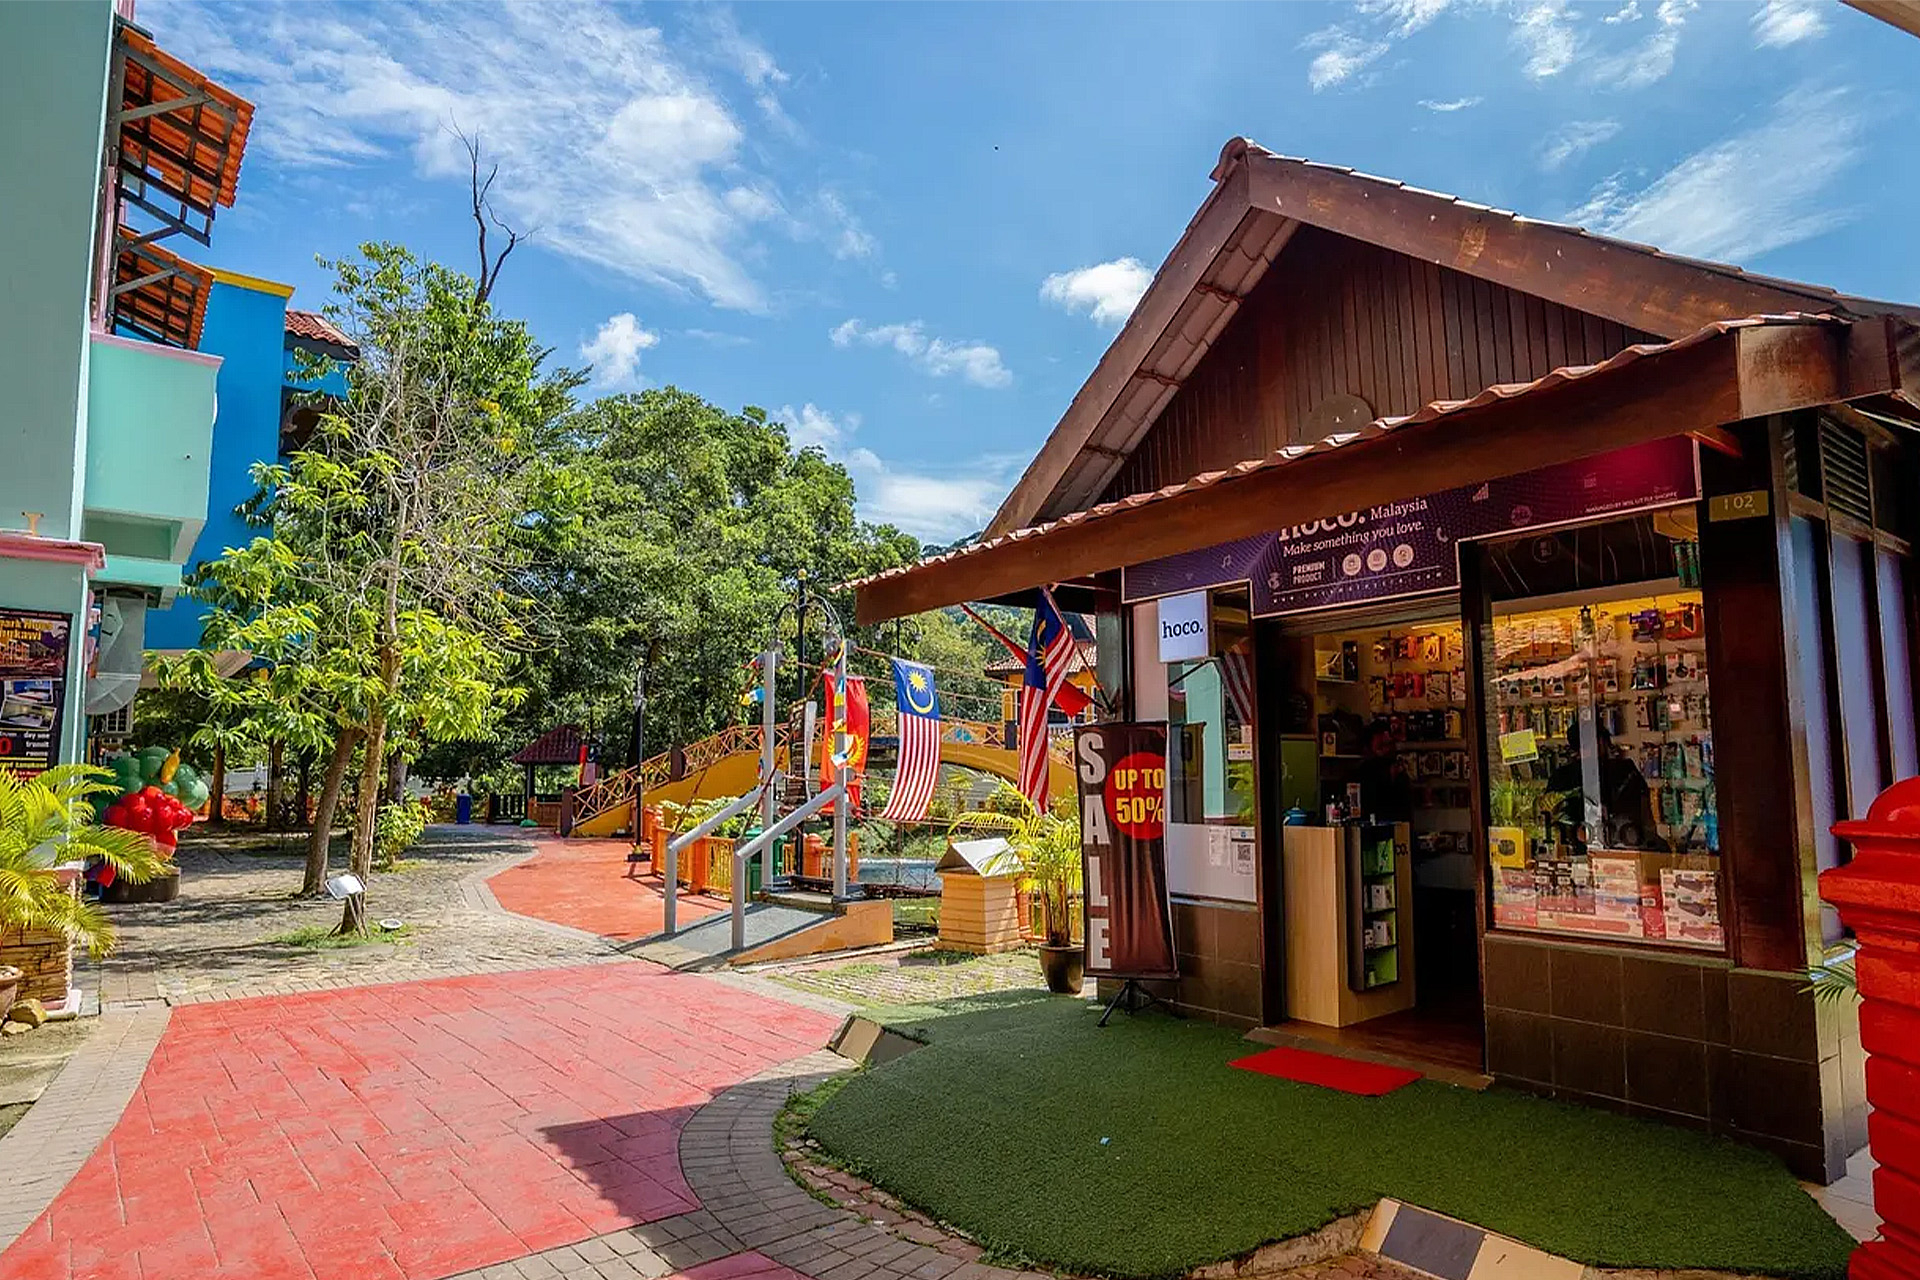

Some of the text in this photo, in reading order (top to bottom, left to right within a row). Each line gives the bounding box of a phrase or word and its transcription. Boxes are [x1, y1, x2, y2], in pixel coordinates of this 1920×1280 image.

[1370, 497, 1428, 520] Malaysia
[1723, 495, 1754, 511] 102
[1283, 520, 1425, 558] Make something you love.
[1292, 560, 1326, 576] PREMIUM
[1292, 571, 1323, 586] PRODUCT
[1162, 620, 1204, 639] hoco.
[1114, 767, 1165, 790] UP TO
[1116, 796, 1165, 824] 50%
[1080, 732, 1112, 970] SALE
